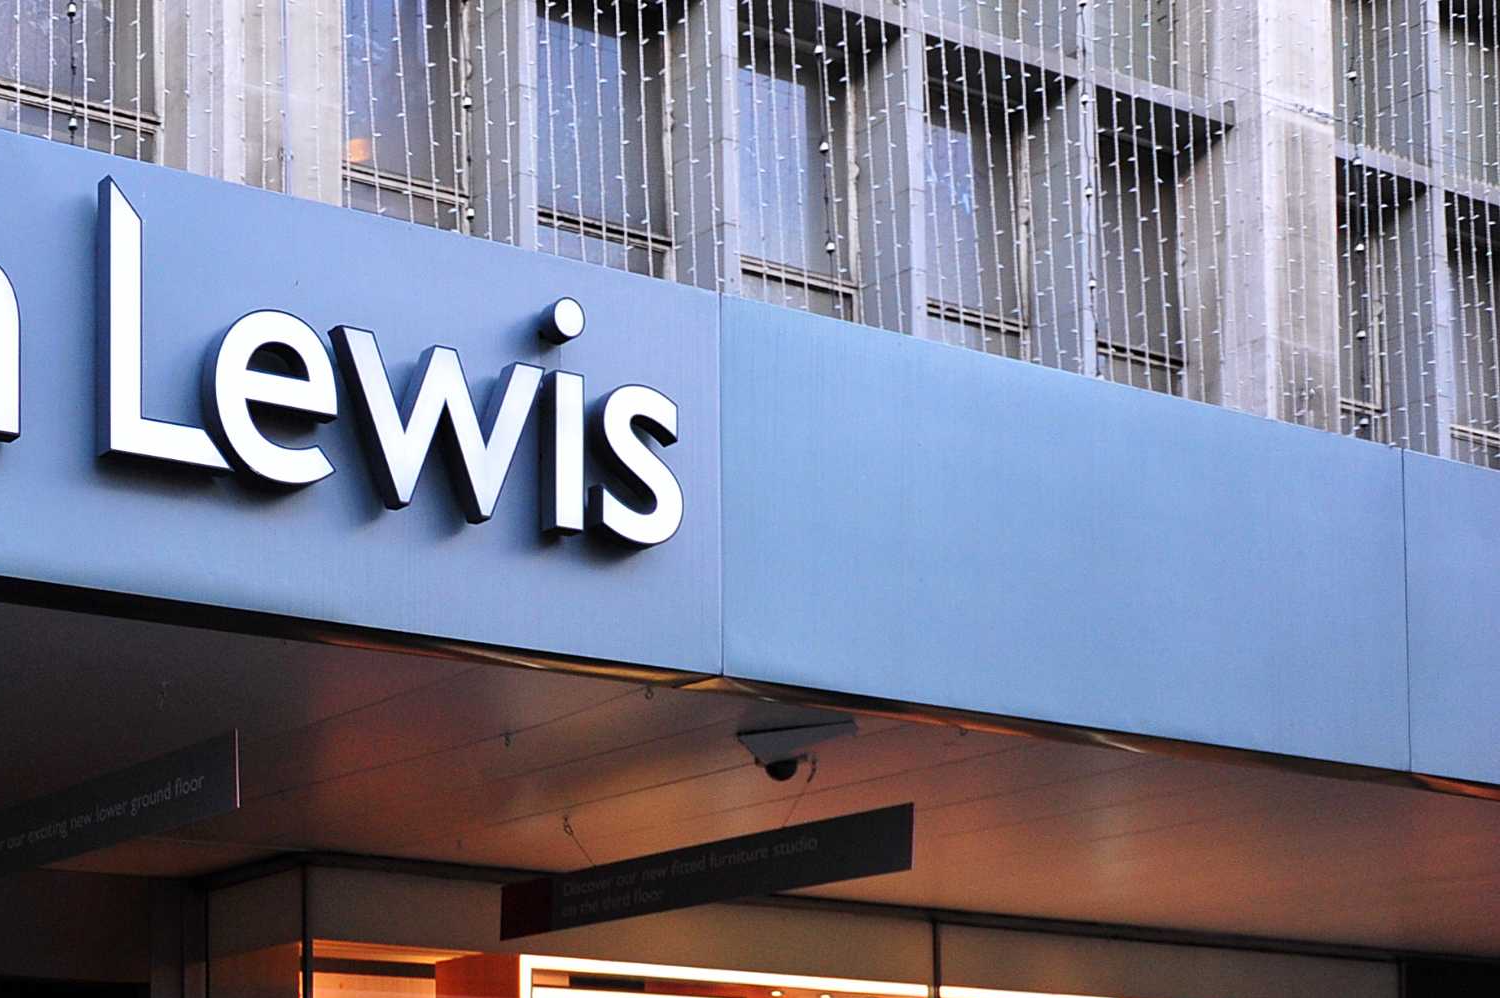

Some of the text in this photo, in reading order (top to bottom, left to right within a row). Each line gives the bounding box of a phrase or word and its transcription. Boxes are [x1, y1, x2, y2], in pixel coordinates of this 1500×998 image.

[98, 175, 684, 549] Lewis
[70, 812, 93, 830] new
[94, 801, 128, 823] lower
[129, 781, 171, 817] ground
[174, 776, 204, 798] floor
[641, 865, 668, 882] new
[709, 846, 769, 870] furniture
[771, 835, 819, 858] studio
